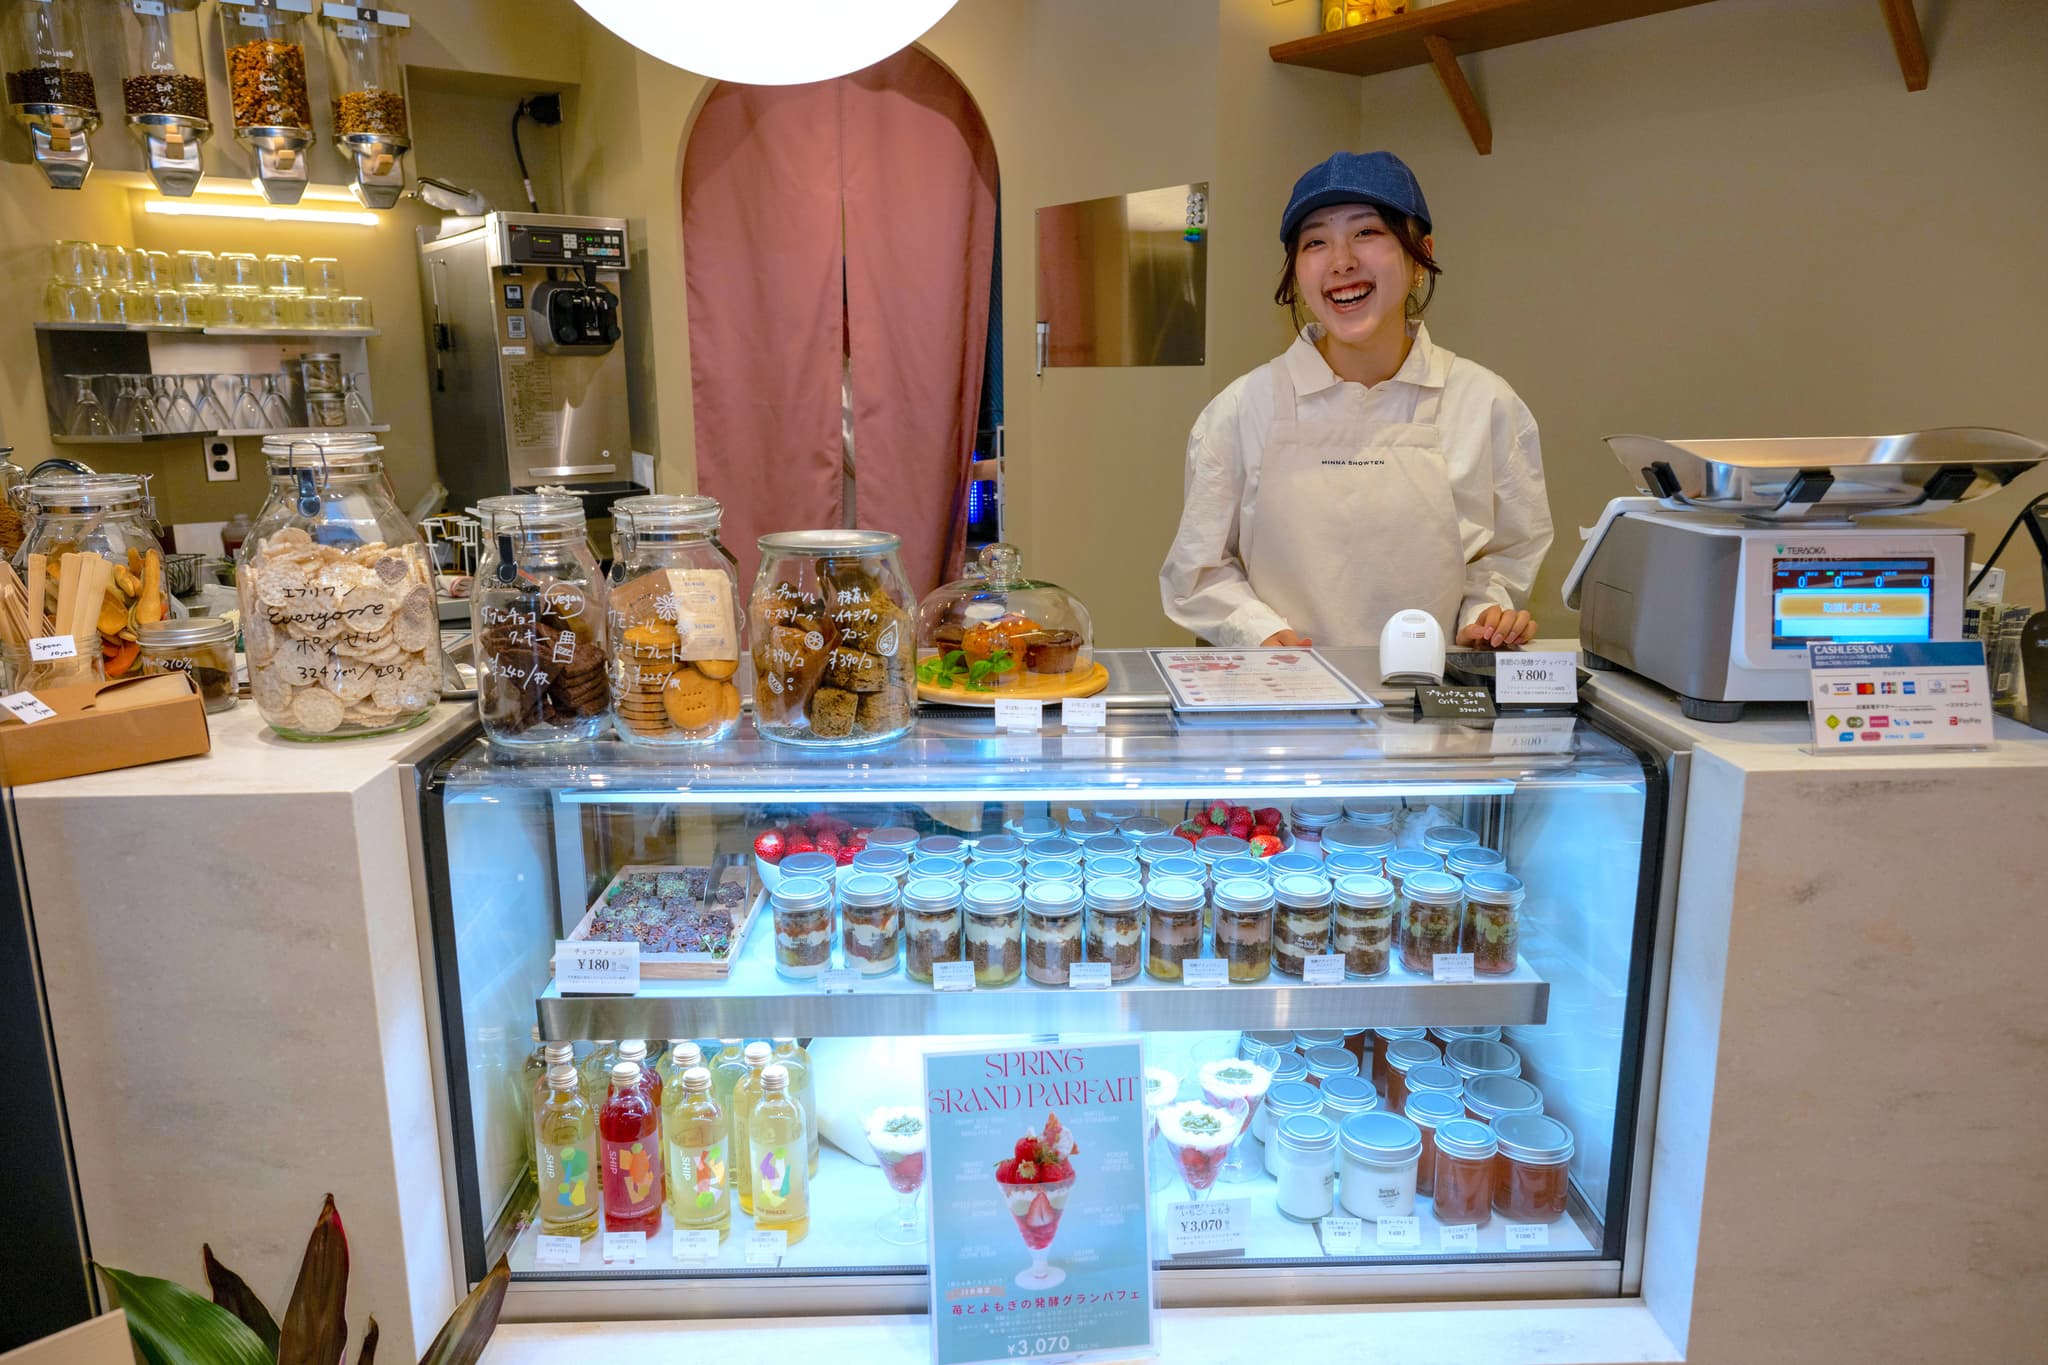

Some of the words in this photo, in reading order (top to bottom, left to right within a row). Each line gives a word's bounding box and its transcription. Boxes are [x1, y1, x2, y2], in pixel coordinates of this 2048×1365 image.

[363, 10, 371, 20] 4
[1787, 546, 1826, 555] TERAOKA
[1798, 576, 1806, 588] 0
[1834, 576, 1843, 588] 0
[1875, 576, 1883, 588] 0
[1921, 575, 1930, 588] 0
[281, 582, 358, 599] エブリワン
[551, 593, 582, 611] vegan
[266, 603, 384, 631] Everyone
[295, 631, 381, 656] ポンせん
[508, 628, 552, 648] クッキー
[1814, 644, 1865, 655] CASHLESS
[1866, 643, 1894, 654] ONLY
[297, 666, 329, 680] 324
[1516, 669, 1548, 681] ¥800
[578, 959, 609, 970] ¥180
[985, 1048, 1085, 1079] SPRING
[928, 1085, 1022, 1114] GRAND
[1028, 1077, 1140, 1108] PARFAIT
[1181, 1218, 1223, 1233] ¥3,070
[1007, 1335, 1071, 1357] ¥3,070
